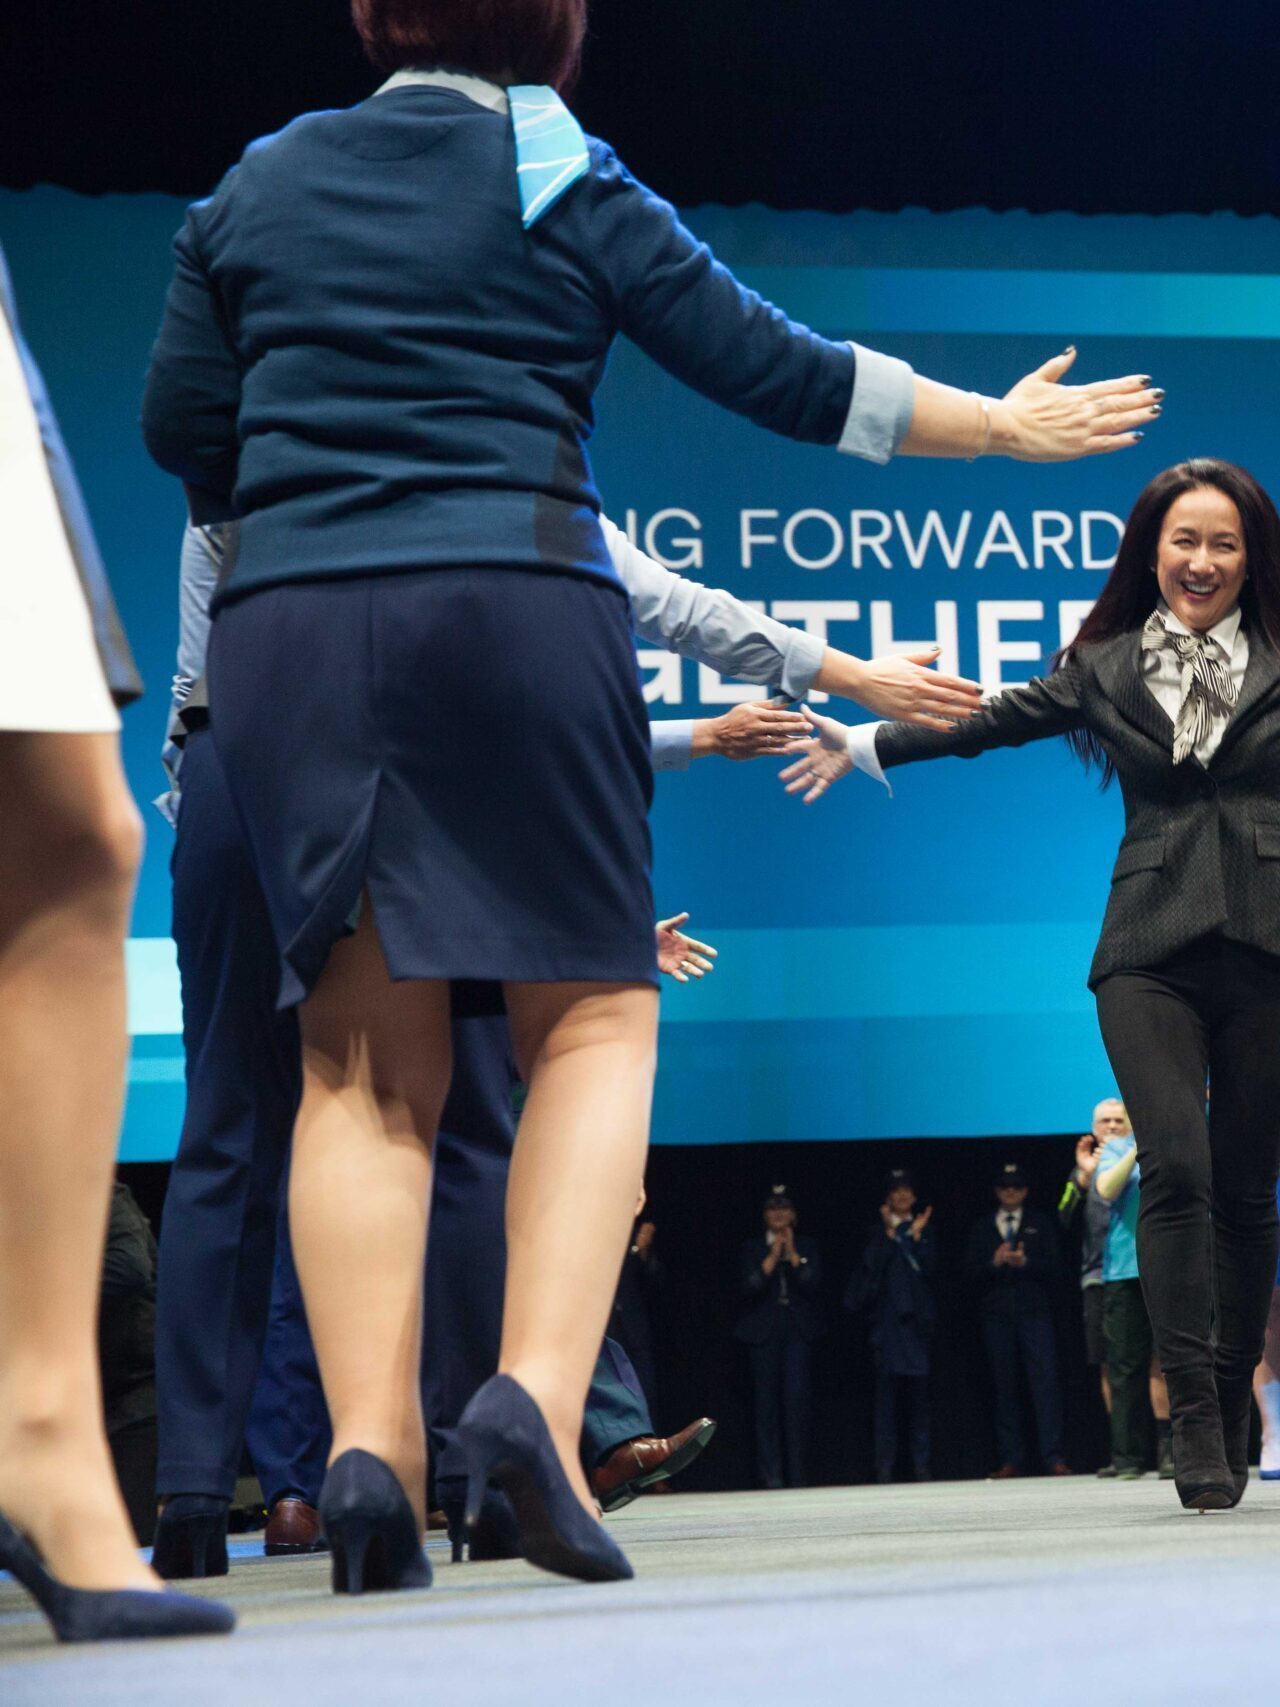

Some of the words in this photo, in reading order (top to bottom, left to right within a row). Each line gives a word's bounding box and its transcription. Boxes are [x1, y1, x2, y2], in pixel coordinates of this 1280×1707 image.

[626, 508, 703, 570] G
[740, 509, 1126, 570] FORWARD
[637, 600, 1098, 704] THE
